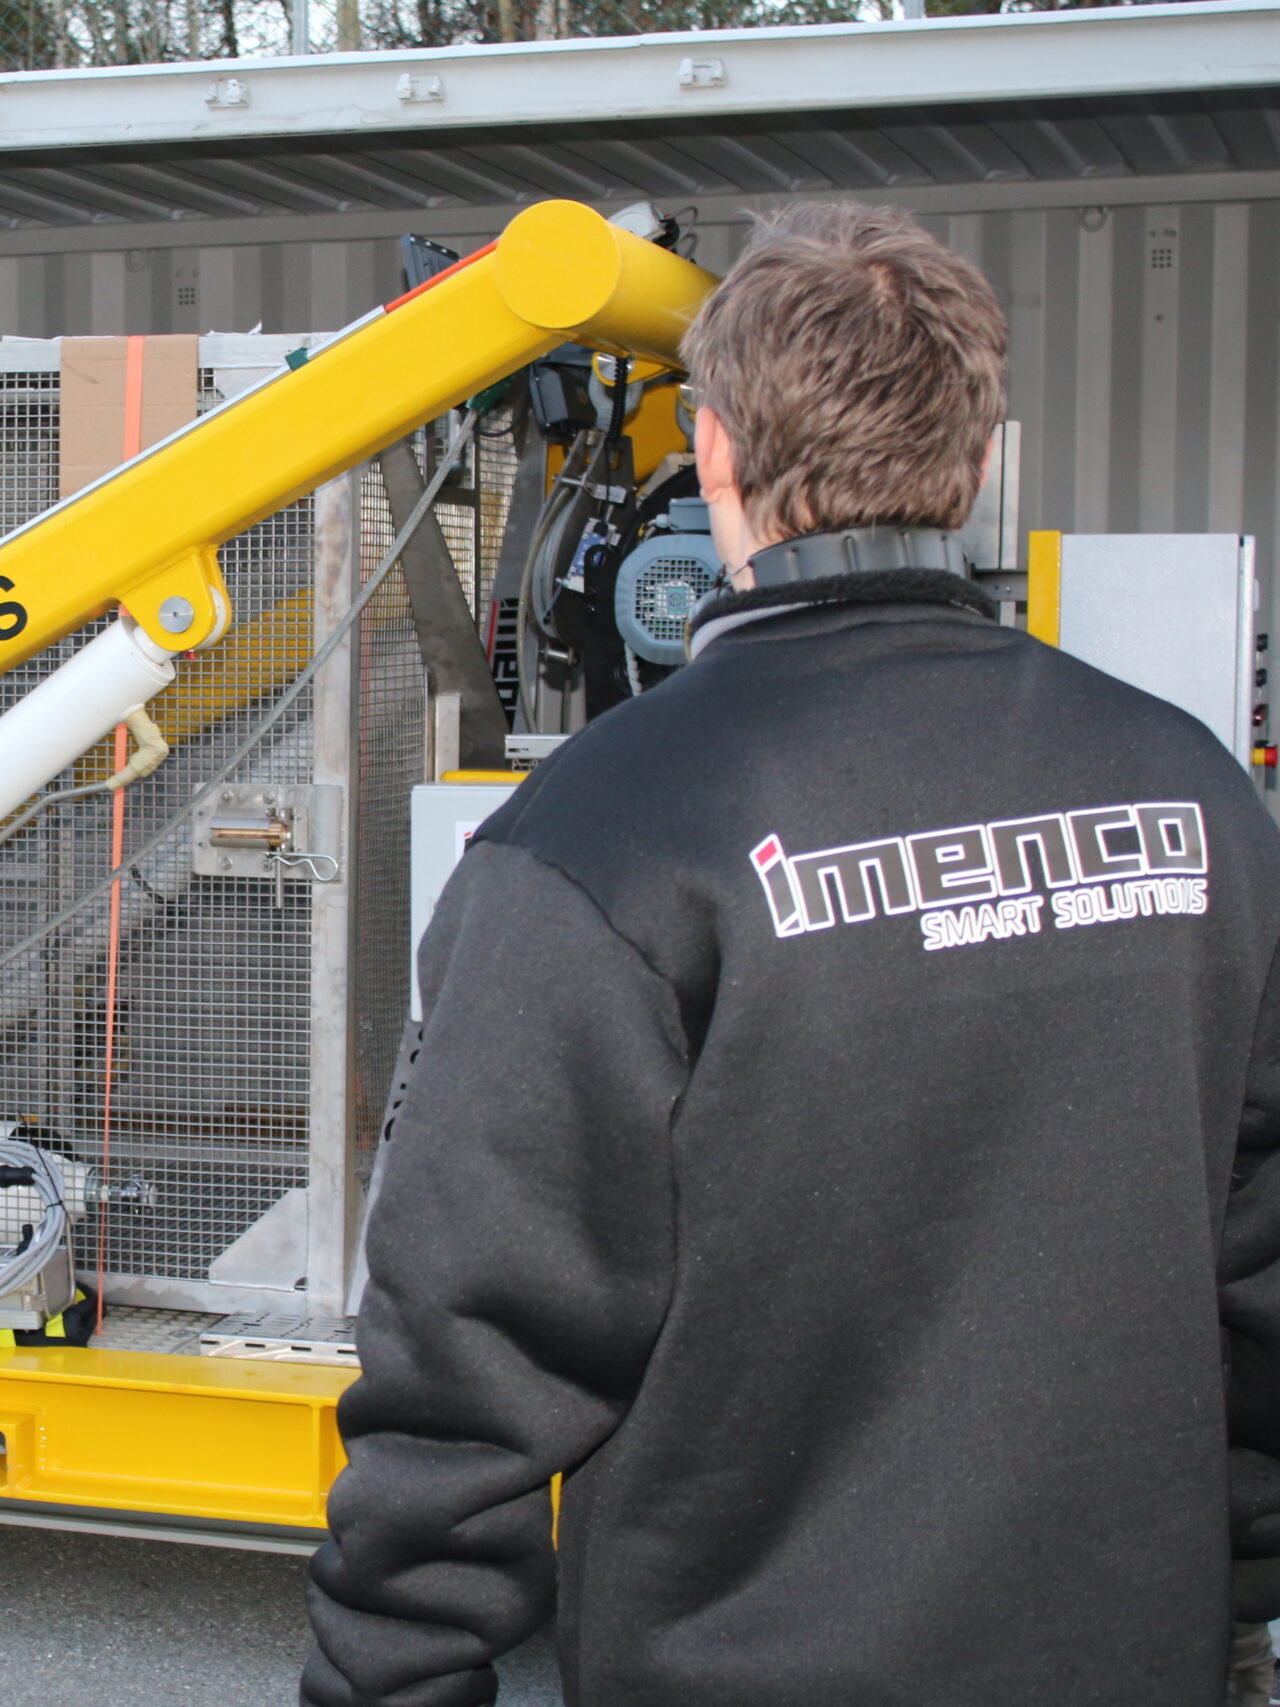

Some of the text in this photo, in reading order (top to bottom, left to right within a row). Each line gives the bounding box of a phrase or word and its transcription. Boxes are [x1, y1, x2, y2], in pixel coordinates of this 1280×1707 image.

[749, 802, 1208, 938] imenco
[921, 878, 1208, 951] SMART SOLUTIONS
